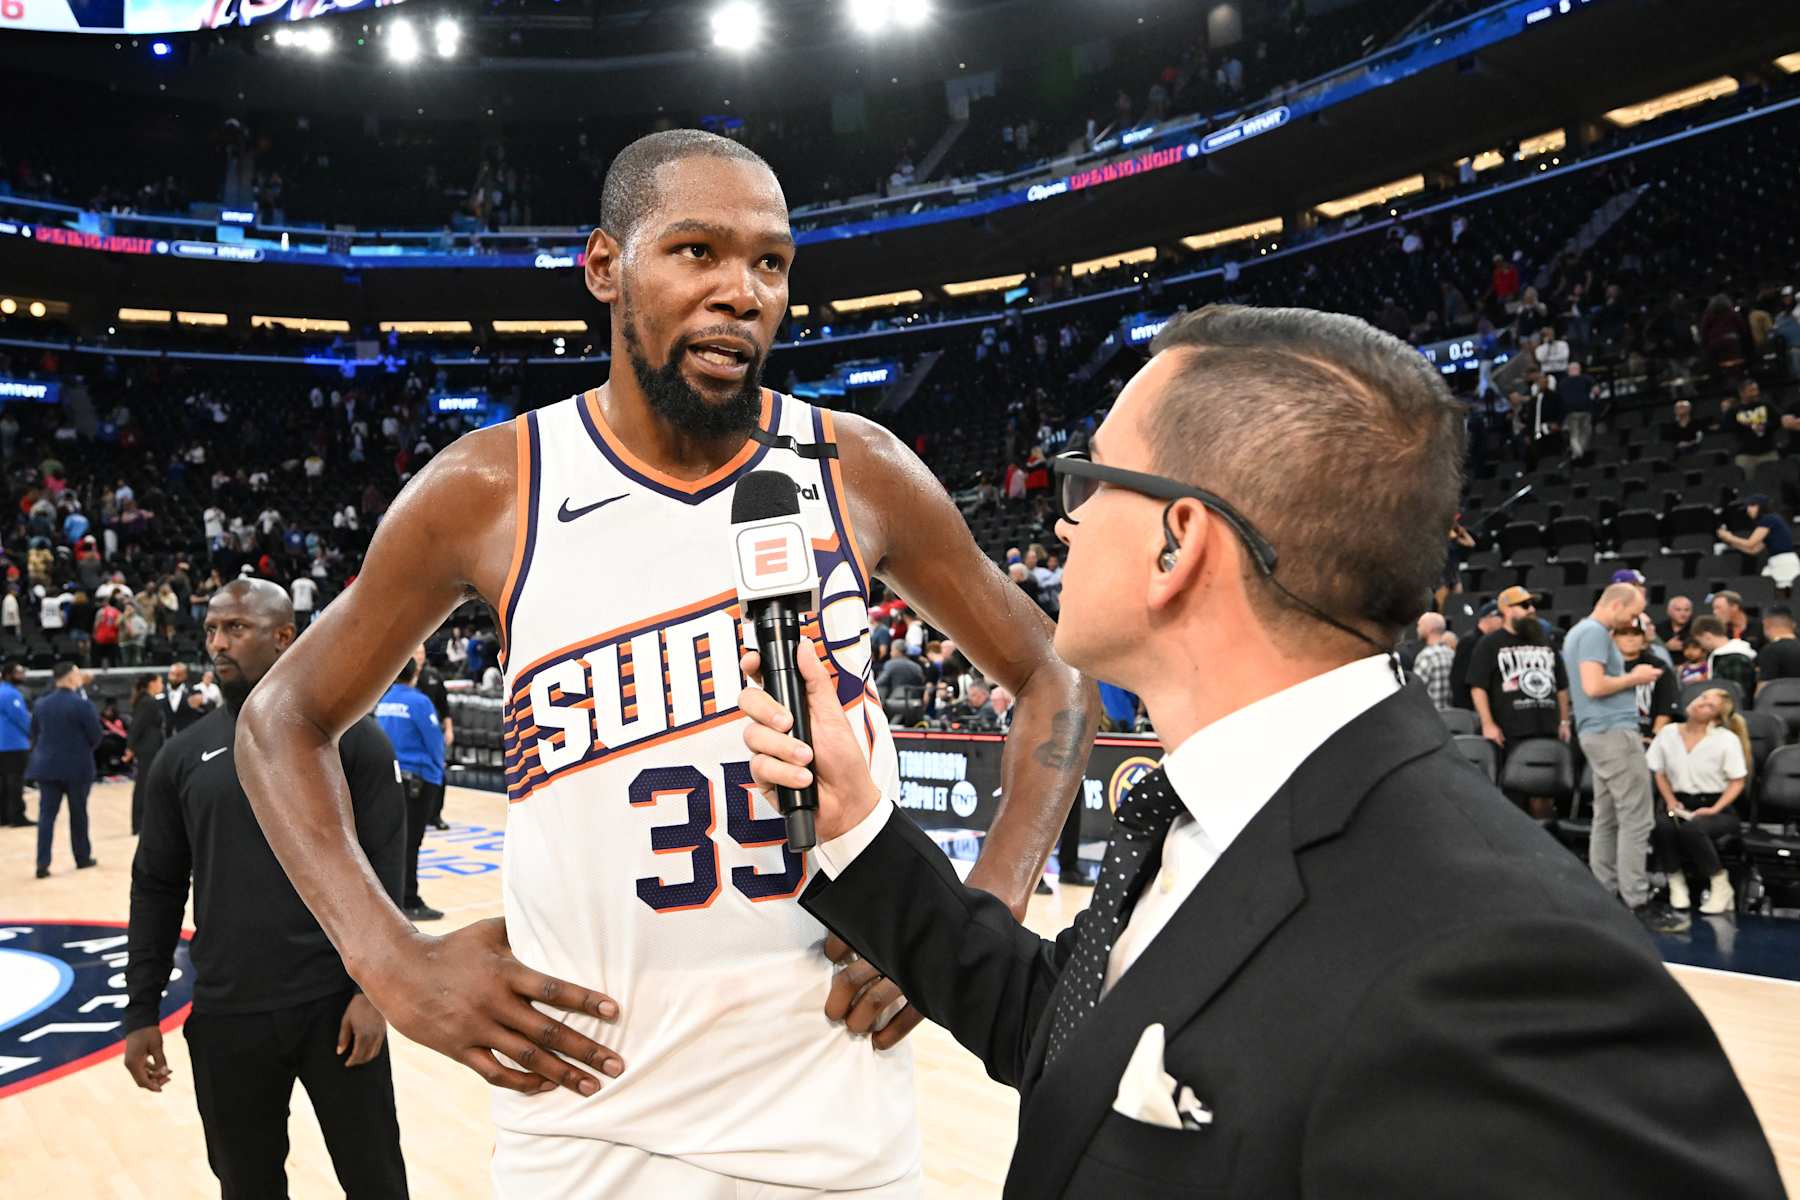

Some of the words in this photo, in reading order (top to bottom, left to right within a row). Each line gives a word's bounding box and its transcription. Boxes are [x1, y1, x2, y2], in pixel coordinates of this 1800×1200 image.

[848, 368, 888, 385] INTUIT
[438, 397, 479, 410] INTUIT
[898, 750, 968, 781] TOMORROW
[934, 786, 949, 811] ET
[1082, 779, 1104, 810] VS
[628, 760, 808, 914] 35
